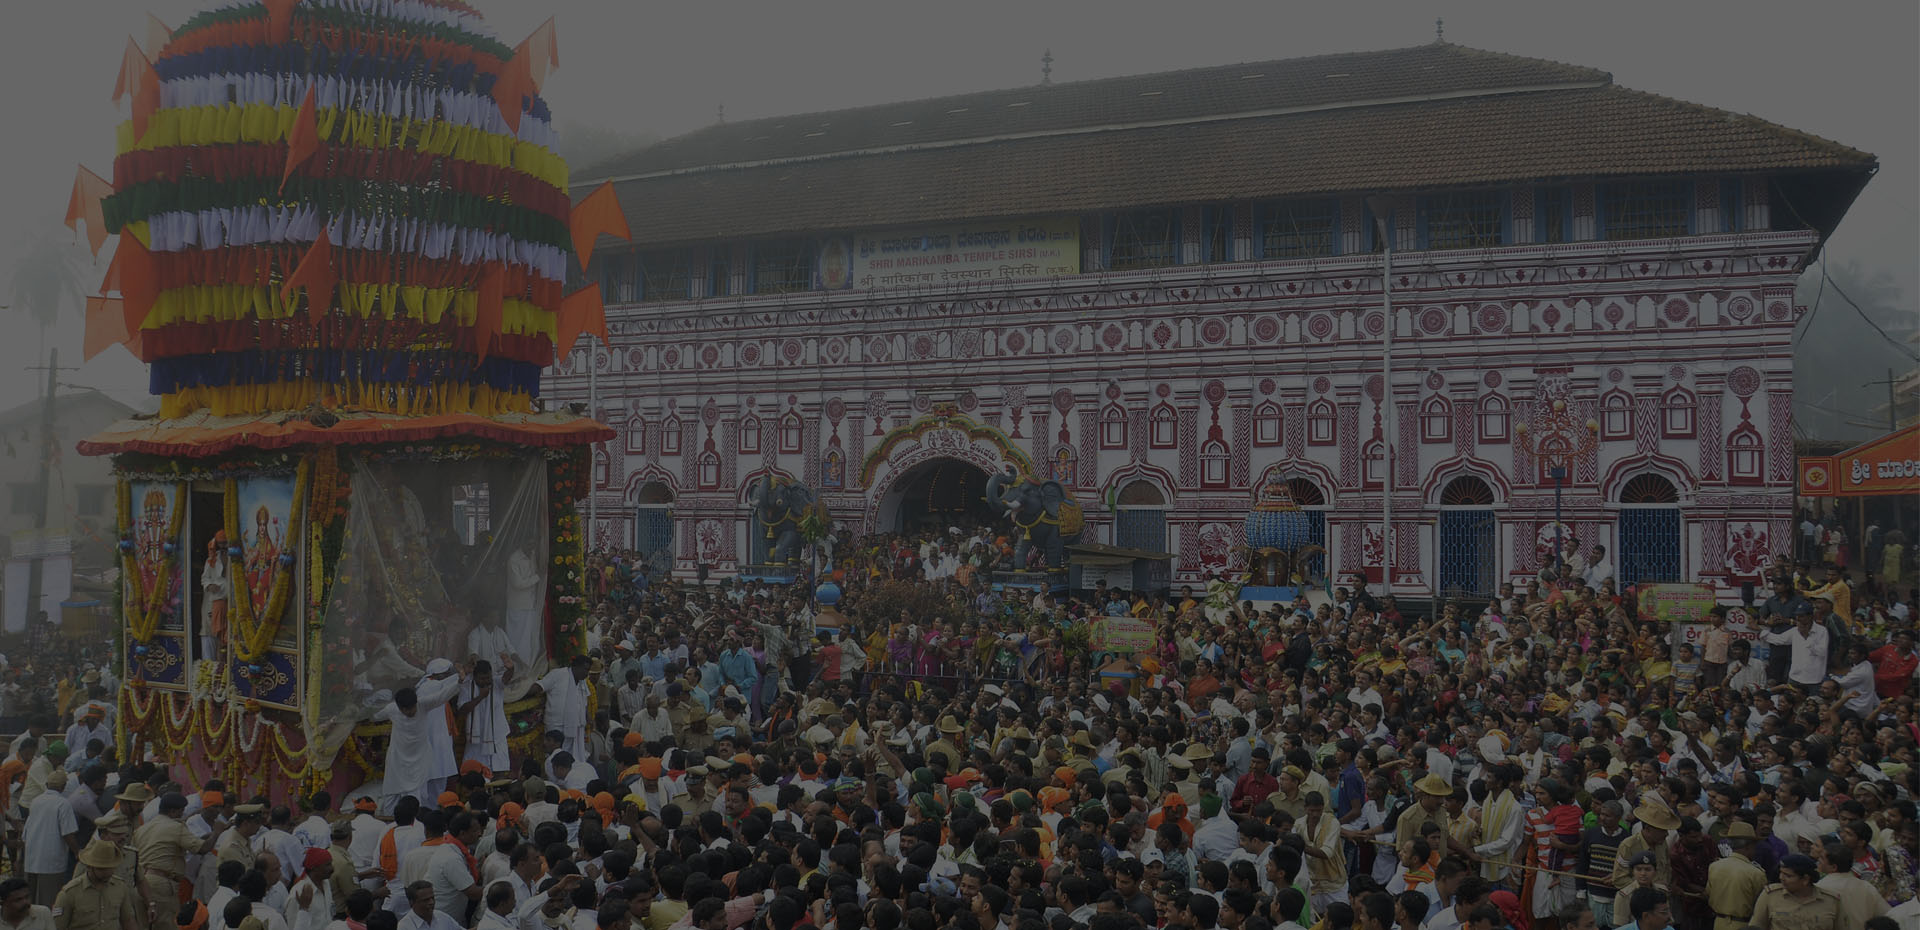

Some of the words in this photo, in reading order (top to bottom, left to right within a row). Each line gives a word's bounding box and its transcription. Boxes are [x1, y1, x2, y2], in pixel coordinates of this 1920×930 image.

[870, 258, 893, 270] SHRI
[897, 253, 960, 268] MARIKAMBA
[963, 250, 1006, 263] TEMPLE
[1008, 247, 1037, 259] SIRSI
[860, 274, 876, 288] श्री
[940, 268, 992, 283] देवस्थान
[1851, 458, 1871, 484] ಶ್ರೀ
